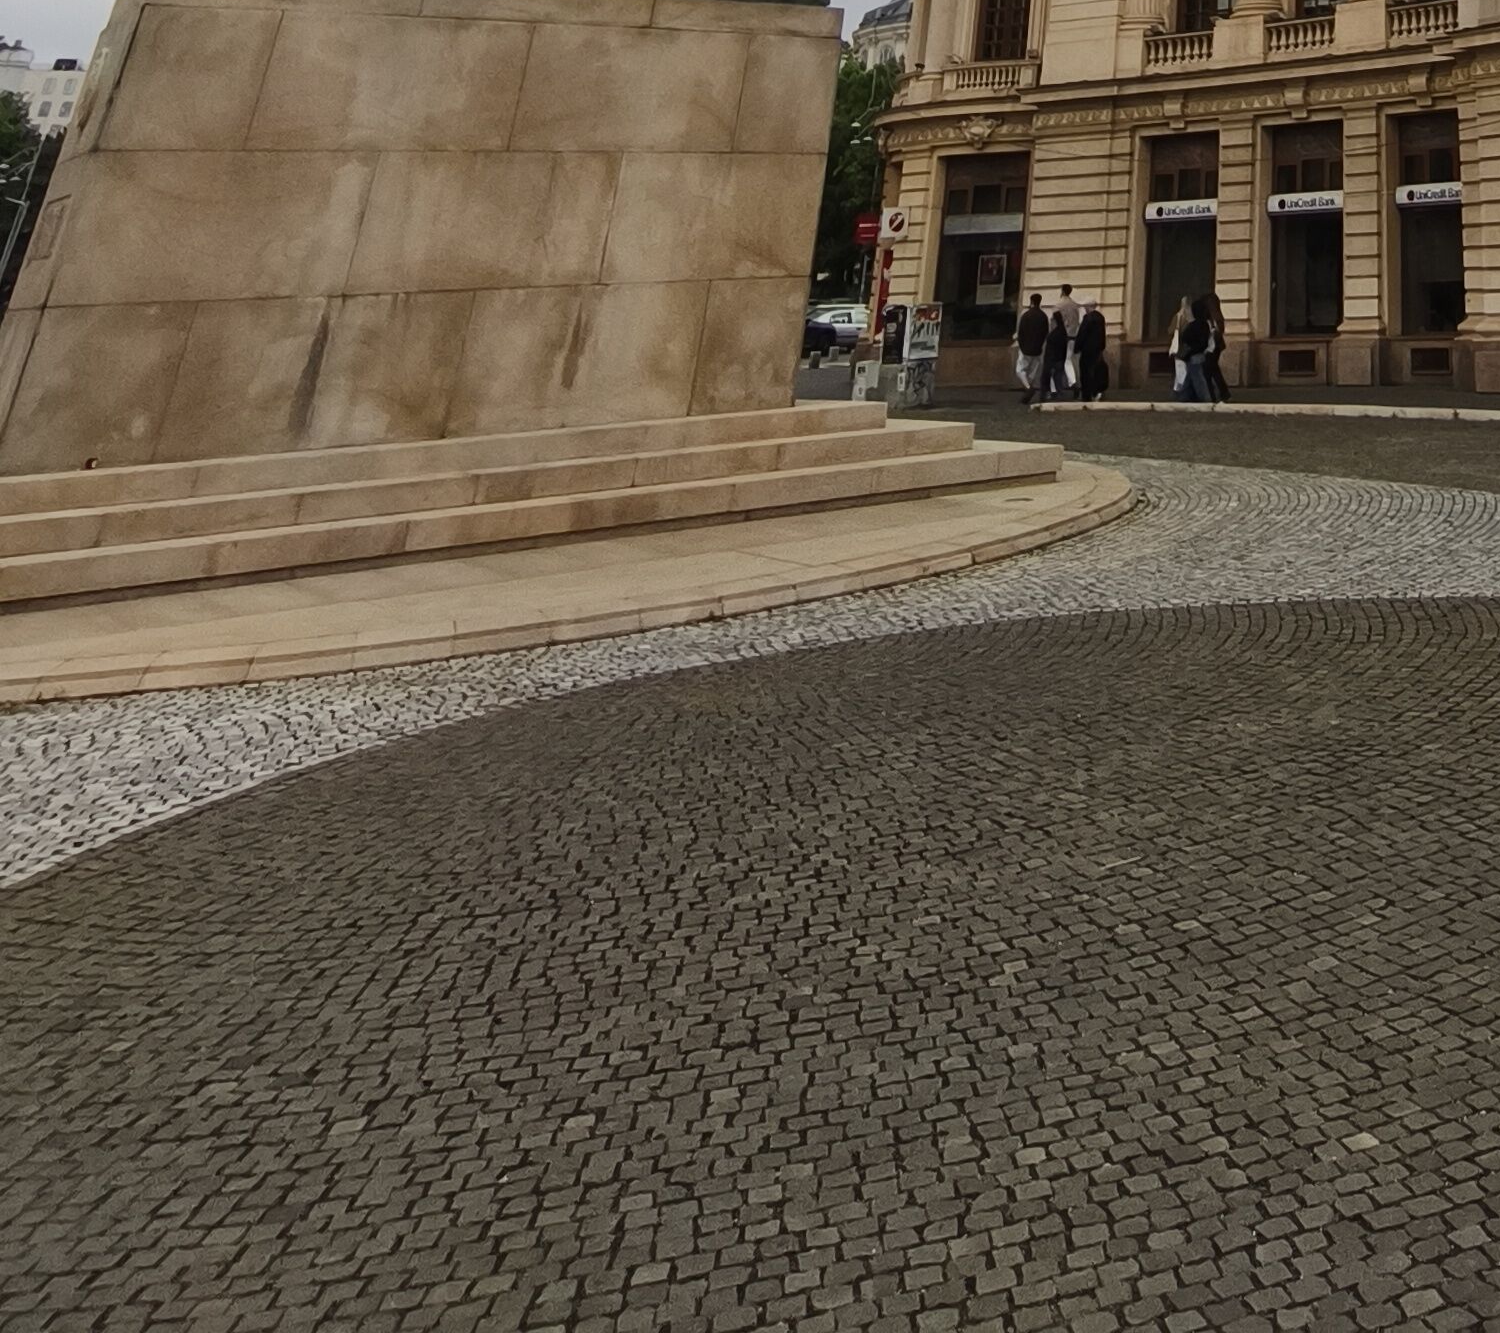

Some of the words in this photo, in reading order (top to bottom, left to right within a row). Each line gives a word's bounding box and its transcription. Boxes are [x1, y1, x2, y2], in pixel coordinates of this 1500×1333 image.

[1447, 187, 1462, 198] Ban
[1286, 197, 1317, 209] UniCredit
[1318, 196, 1336, 207] Bank
